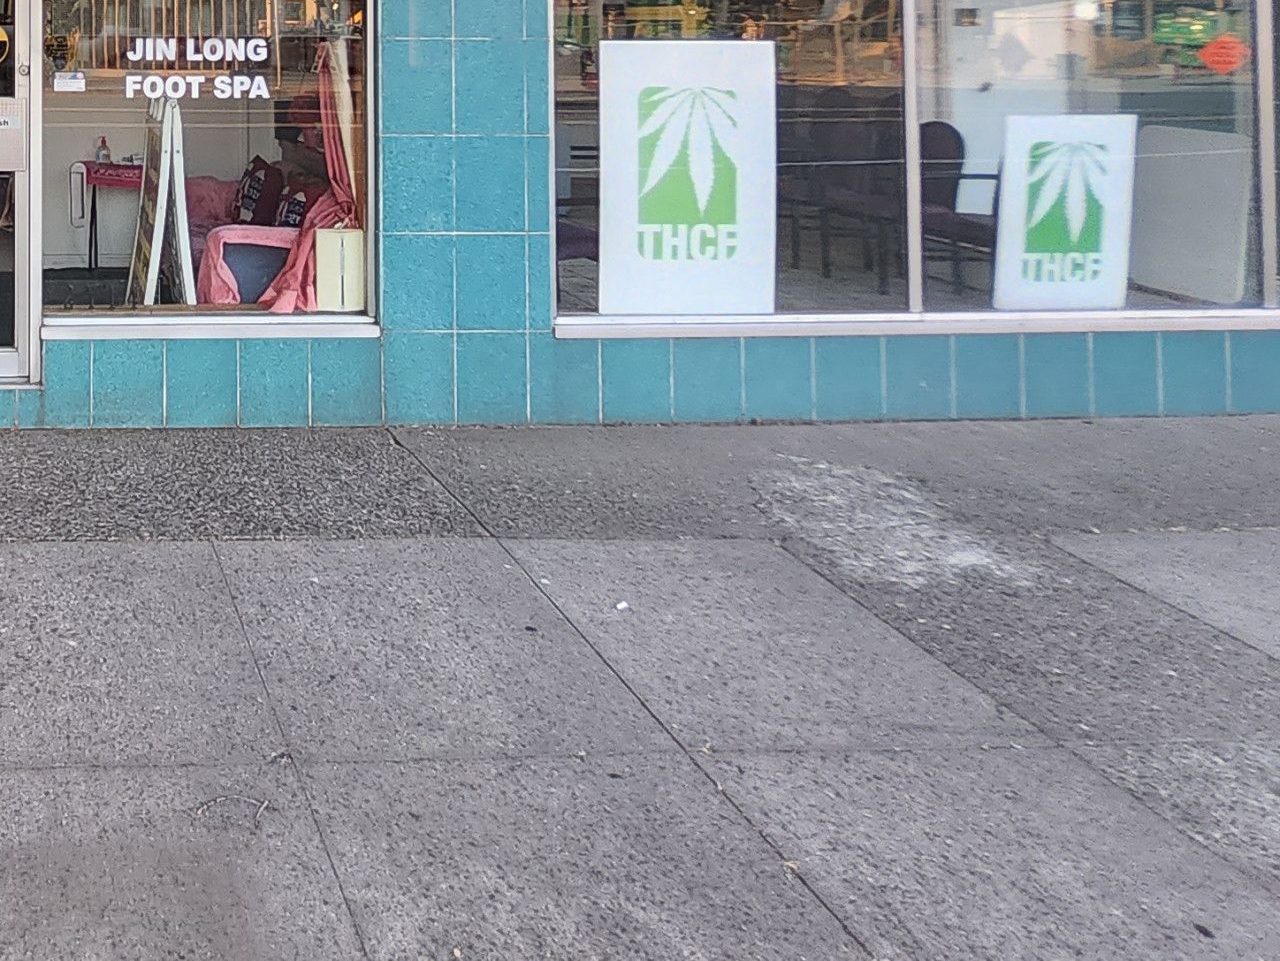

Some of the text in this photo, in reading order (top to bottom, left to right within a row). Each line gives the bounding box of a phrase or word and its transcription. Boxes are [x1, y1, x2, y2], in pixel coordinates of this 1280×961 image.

[126, 38, 268, 62] JIN LONG
[125, 75, 271, 99] FOOT SPA
